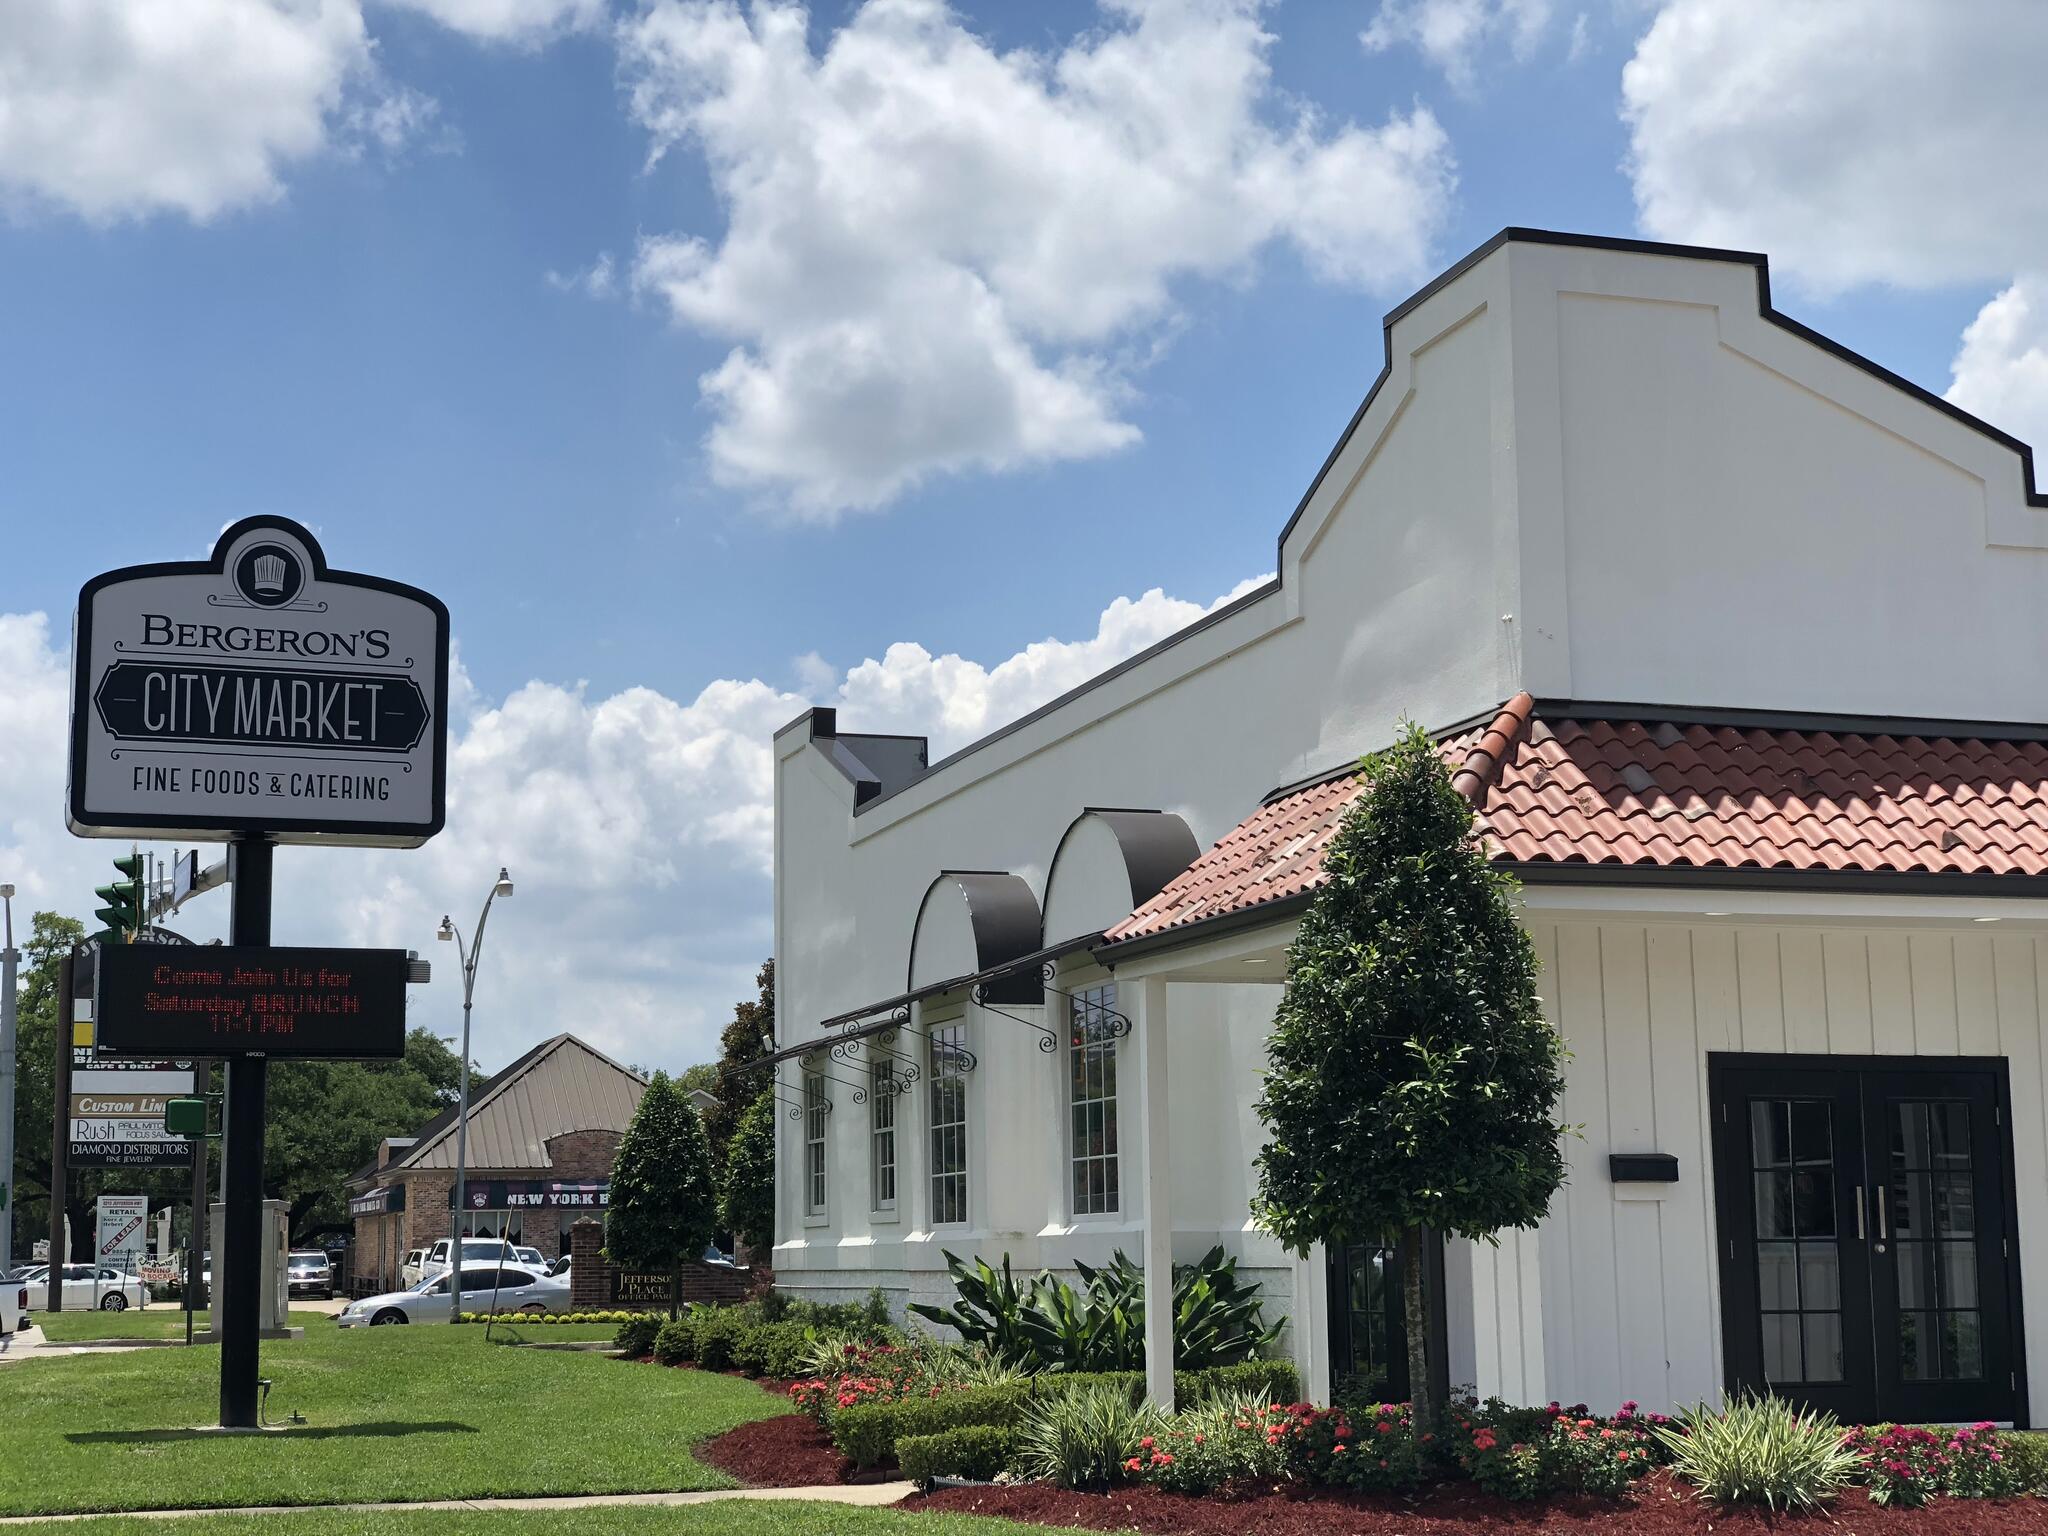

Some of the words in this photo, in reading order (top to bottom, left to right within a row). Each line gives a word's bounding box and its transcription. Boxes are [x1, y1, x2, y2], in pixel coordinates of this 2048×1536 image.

[141, 614, 390, 659] BERGERON'S
[143, 672, 226, 733] CITY
[233, 677, 384, 741] MARKET
[133, 767, 182, 792] FINE
[191, 769, 260, 795] FOODS
[270, 775, 283, 794] &
[290, 773, 390, 800] CATERING
[154, 966, 222, 984] Come
[228, 967, 277, 985] Join
[283, 968, 313, 986] Us
[319, 968, 352, 987] for
[144, 992, 247, 1017] Saturday
[252, 993, 361, 1013] BRUNCH
[211, 1014, 252, 1032] 11-1
[260, 1014, 294, 1033] PM
[79, 1098, 134, 1112] CUSTOM
[76, 1119, 115, 1140] Rush
[72, 1144, 121, 1155] DIAMOND
[123, 1144, 189, 1155] DISTRIBUTORS
[106, 1155, 121, 1163] FINE
[123, 1155, 154, 1164] JEWELRY
[507, 1193, 544, 1205] NEW
[549, 1193, 594, 1205] YORK
[102, 1238, 119, 1254] FOR
[117, 1218, 140, 1240] LEASE
[629, 1284, 664, 1294] PLACE
